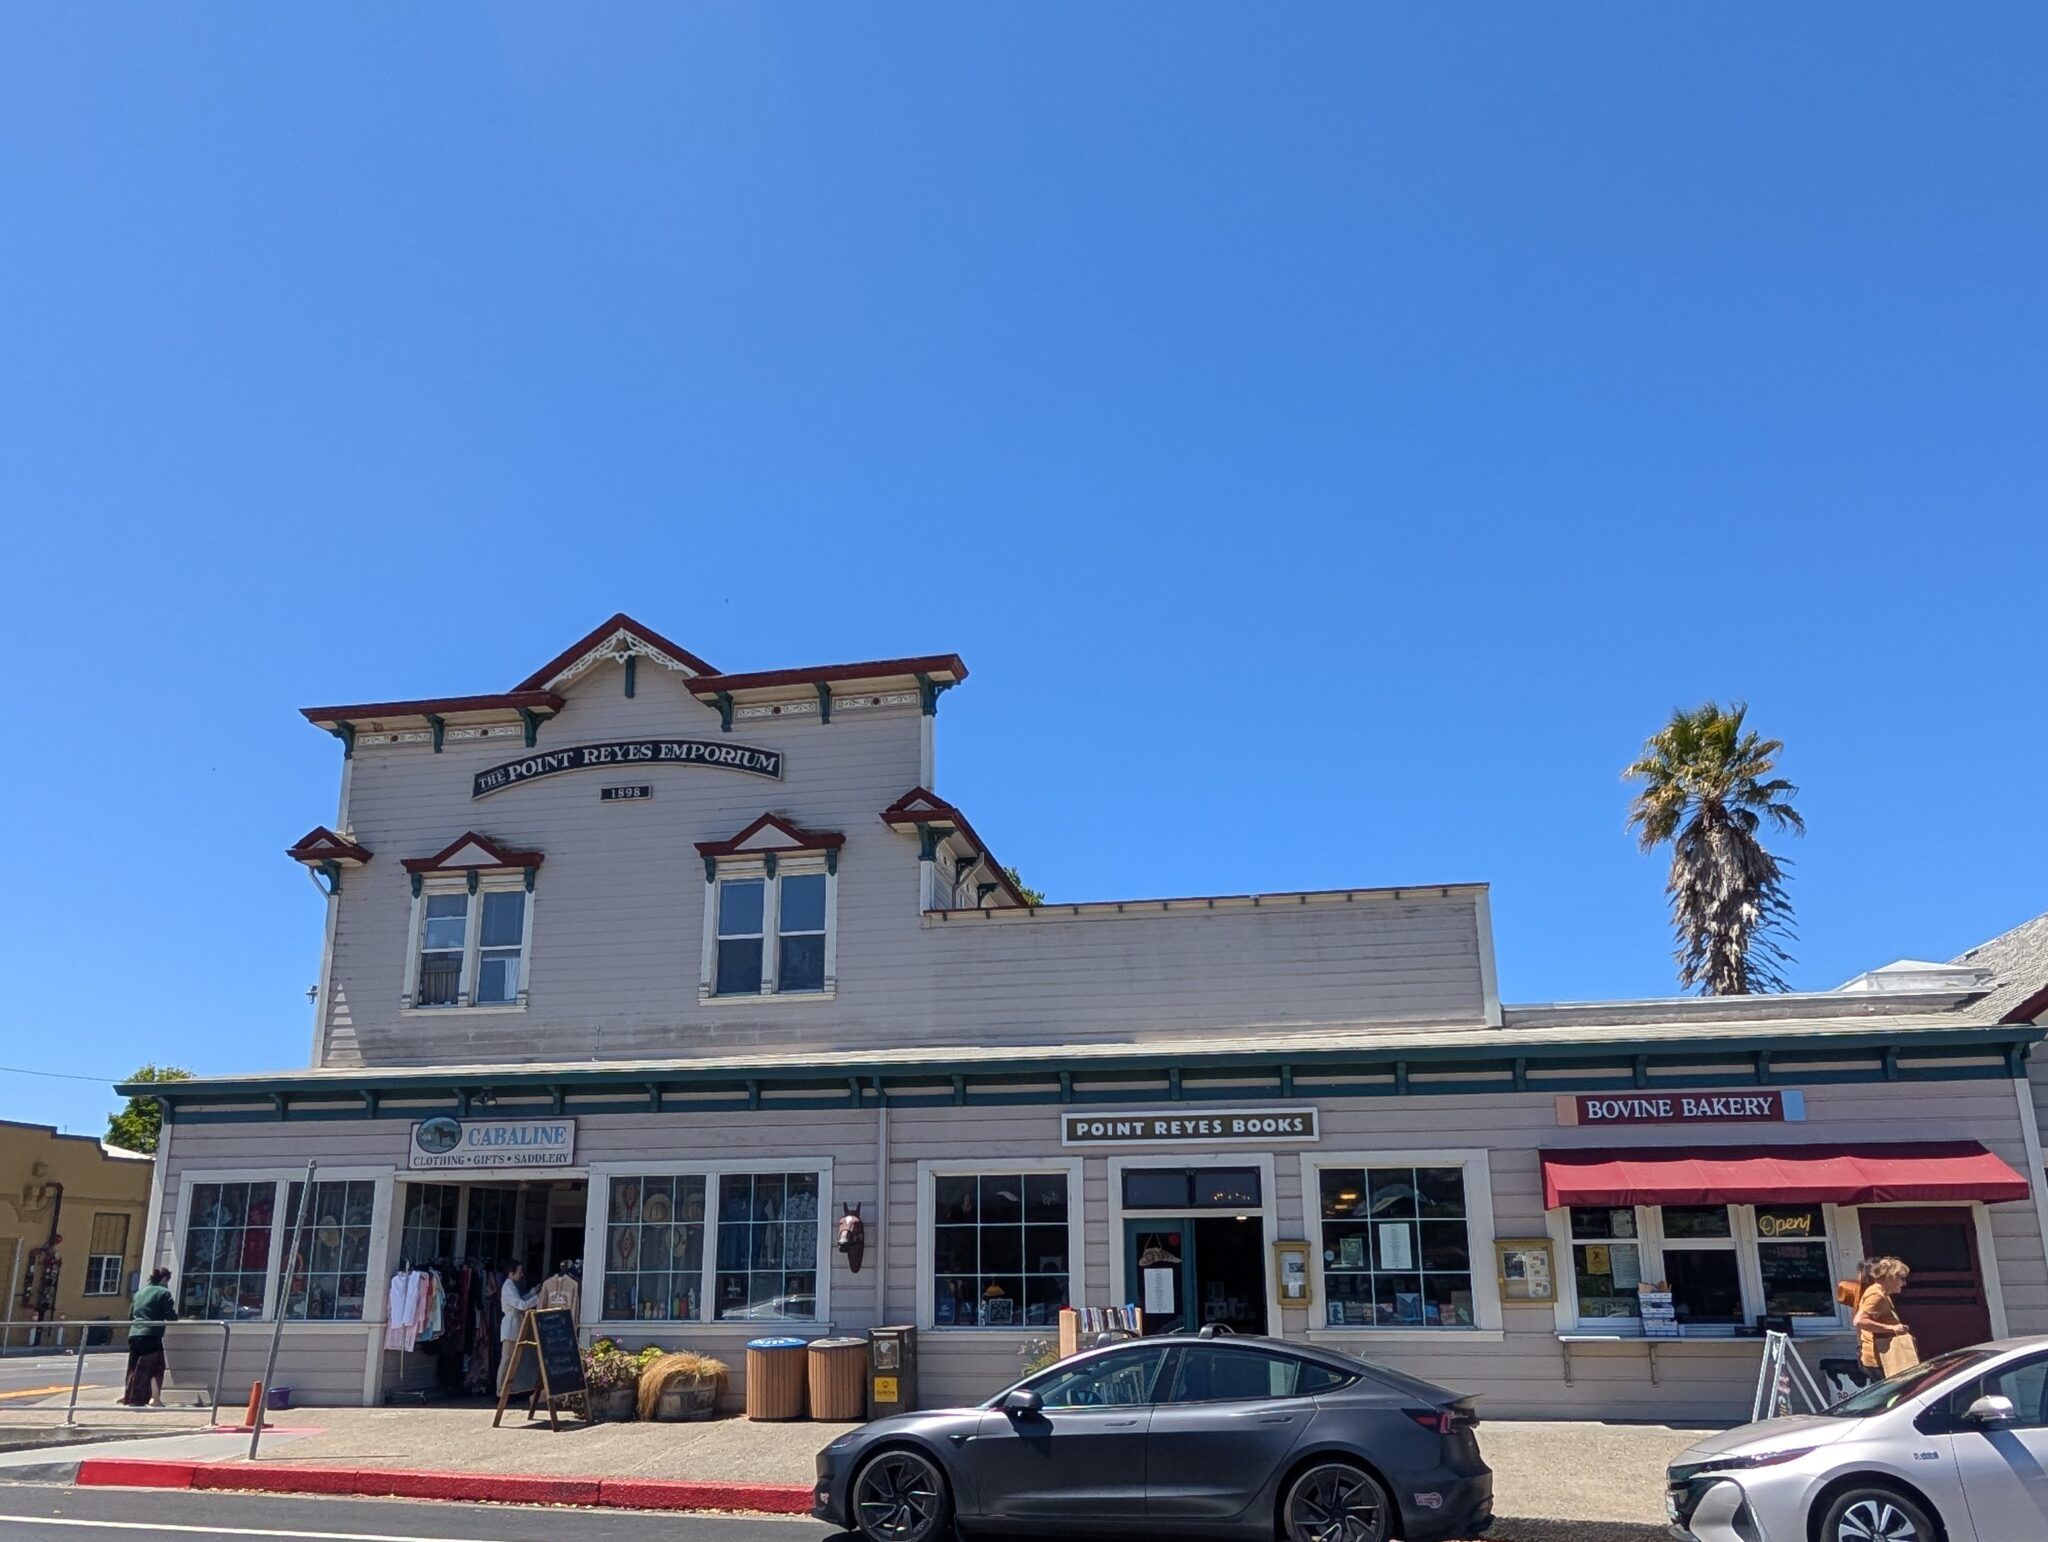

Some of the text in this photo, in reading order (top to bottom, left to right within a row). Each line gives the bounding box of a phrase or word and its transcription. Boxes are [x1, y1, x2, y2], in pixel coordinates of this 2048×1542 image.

[478, 743, 777, 789] THE POINT REYES EMPORIUM
[610, 787, 641, 799] 1898
[1586, 1096, 1773, 1119] BOVINE BAKERY
[468, 1126, 566, 1147] CABALINE
[1076, 1117, 1304, 1136] POINT REYES BOOKS
[413, 1152, 569, 1167] CLOTHING GIFTS SADDLERY
